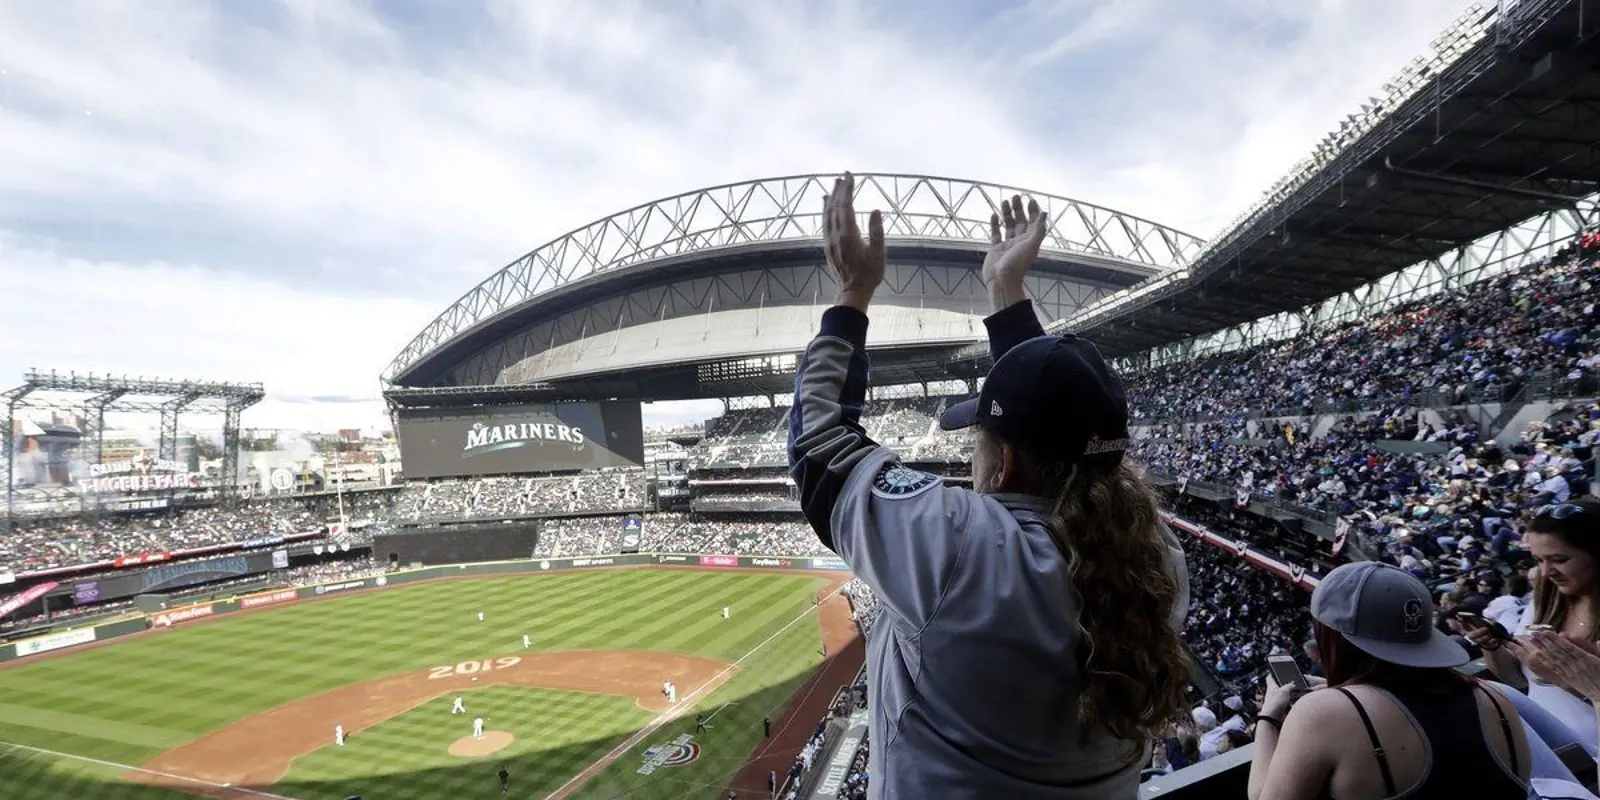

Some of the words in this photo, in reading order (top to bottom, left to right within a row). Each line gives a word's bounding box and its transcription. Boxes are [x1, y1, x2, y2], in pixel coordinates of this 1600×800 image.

[464, 423, 584, 450] MARINERS
[752, 558, 780, 567] KeyBank
[427, 656, 522, 680] 2019
